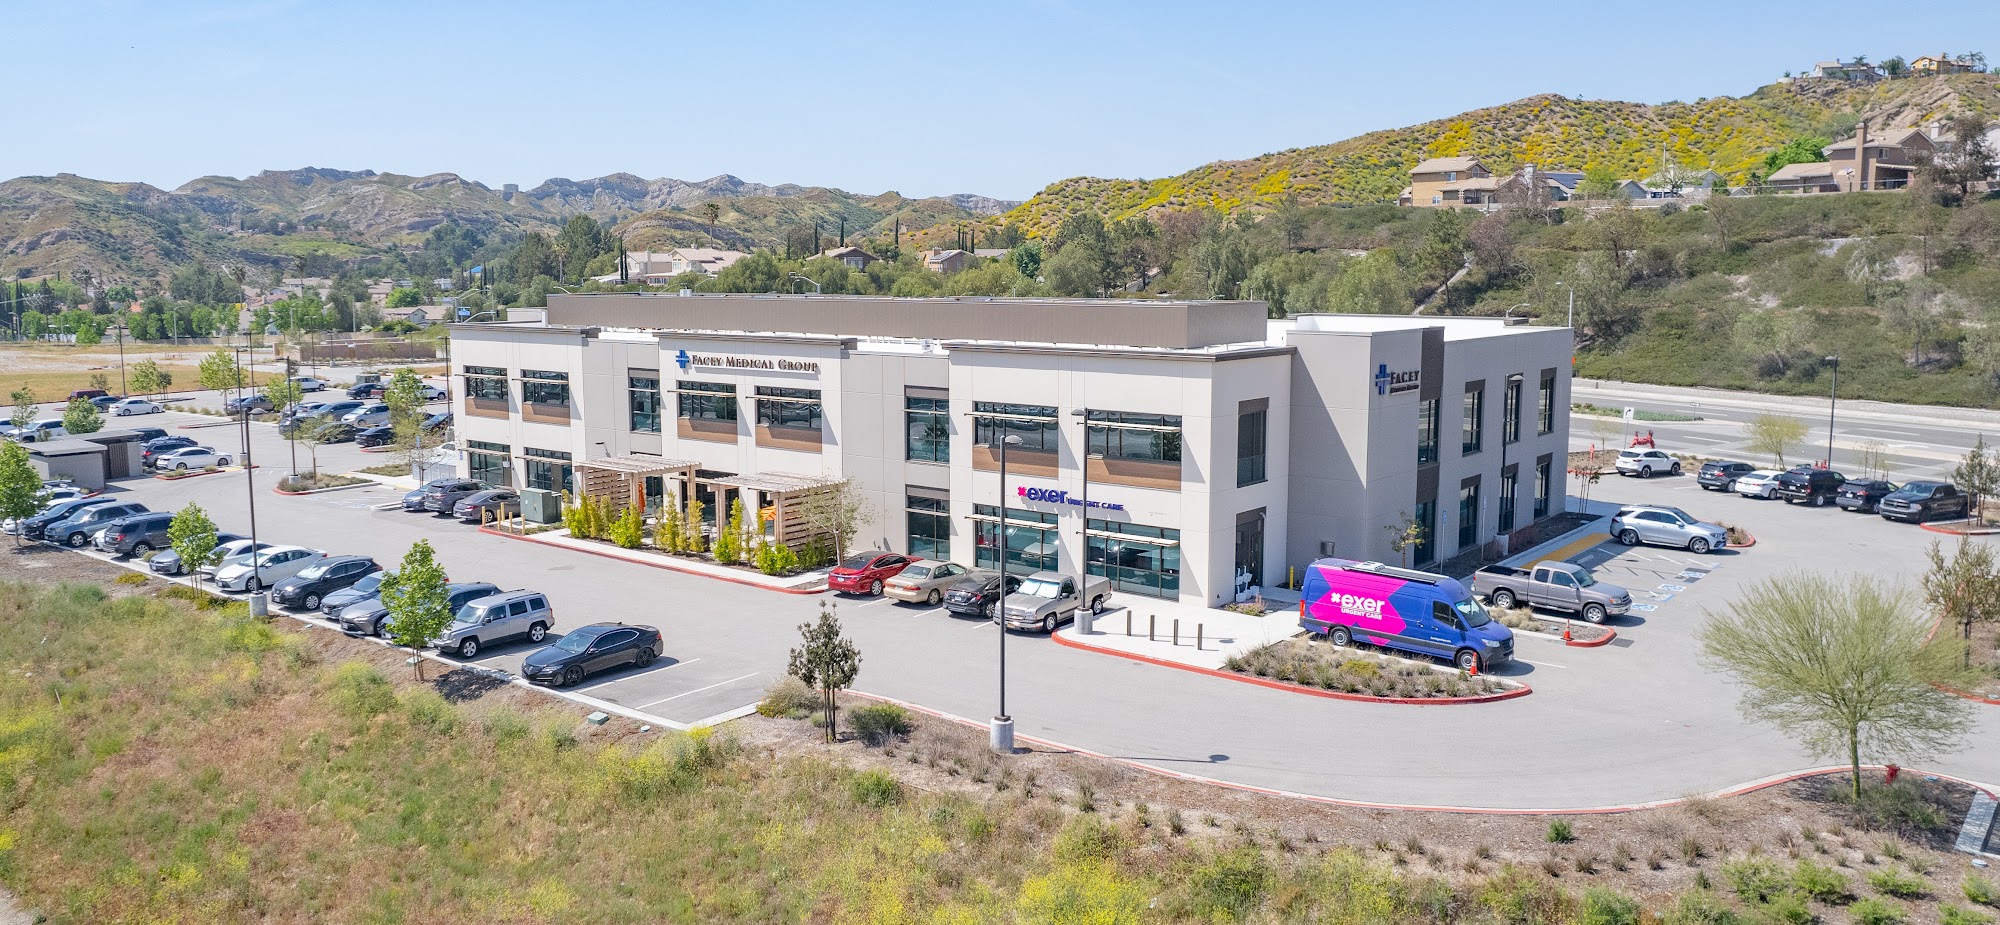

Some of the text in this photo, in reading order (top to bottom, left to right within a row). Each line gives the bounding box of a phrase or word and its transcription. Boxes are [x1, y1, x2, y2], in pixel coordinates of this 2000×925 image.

[692, 354, 818, 371] FACEY MEDICAL GROUP
[1390, 370, 1419, 384] FACEY
[1027, 487, 1068, 504] exer
[1101, 502, 1124, 511] CARE
[1341, 594, 1385, 613] exer
[1341, 607, 1383, 620] URGENT CARE
